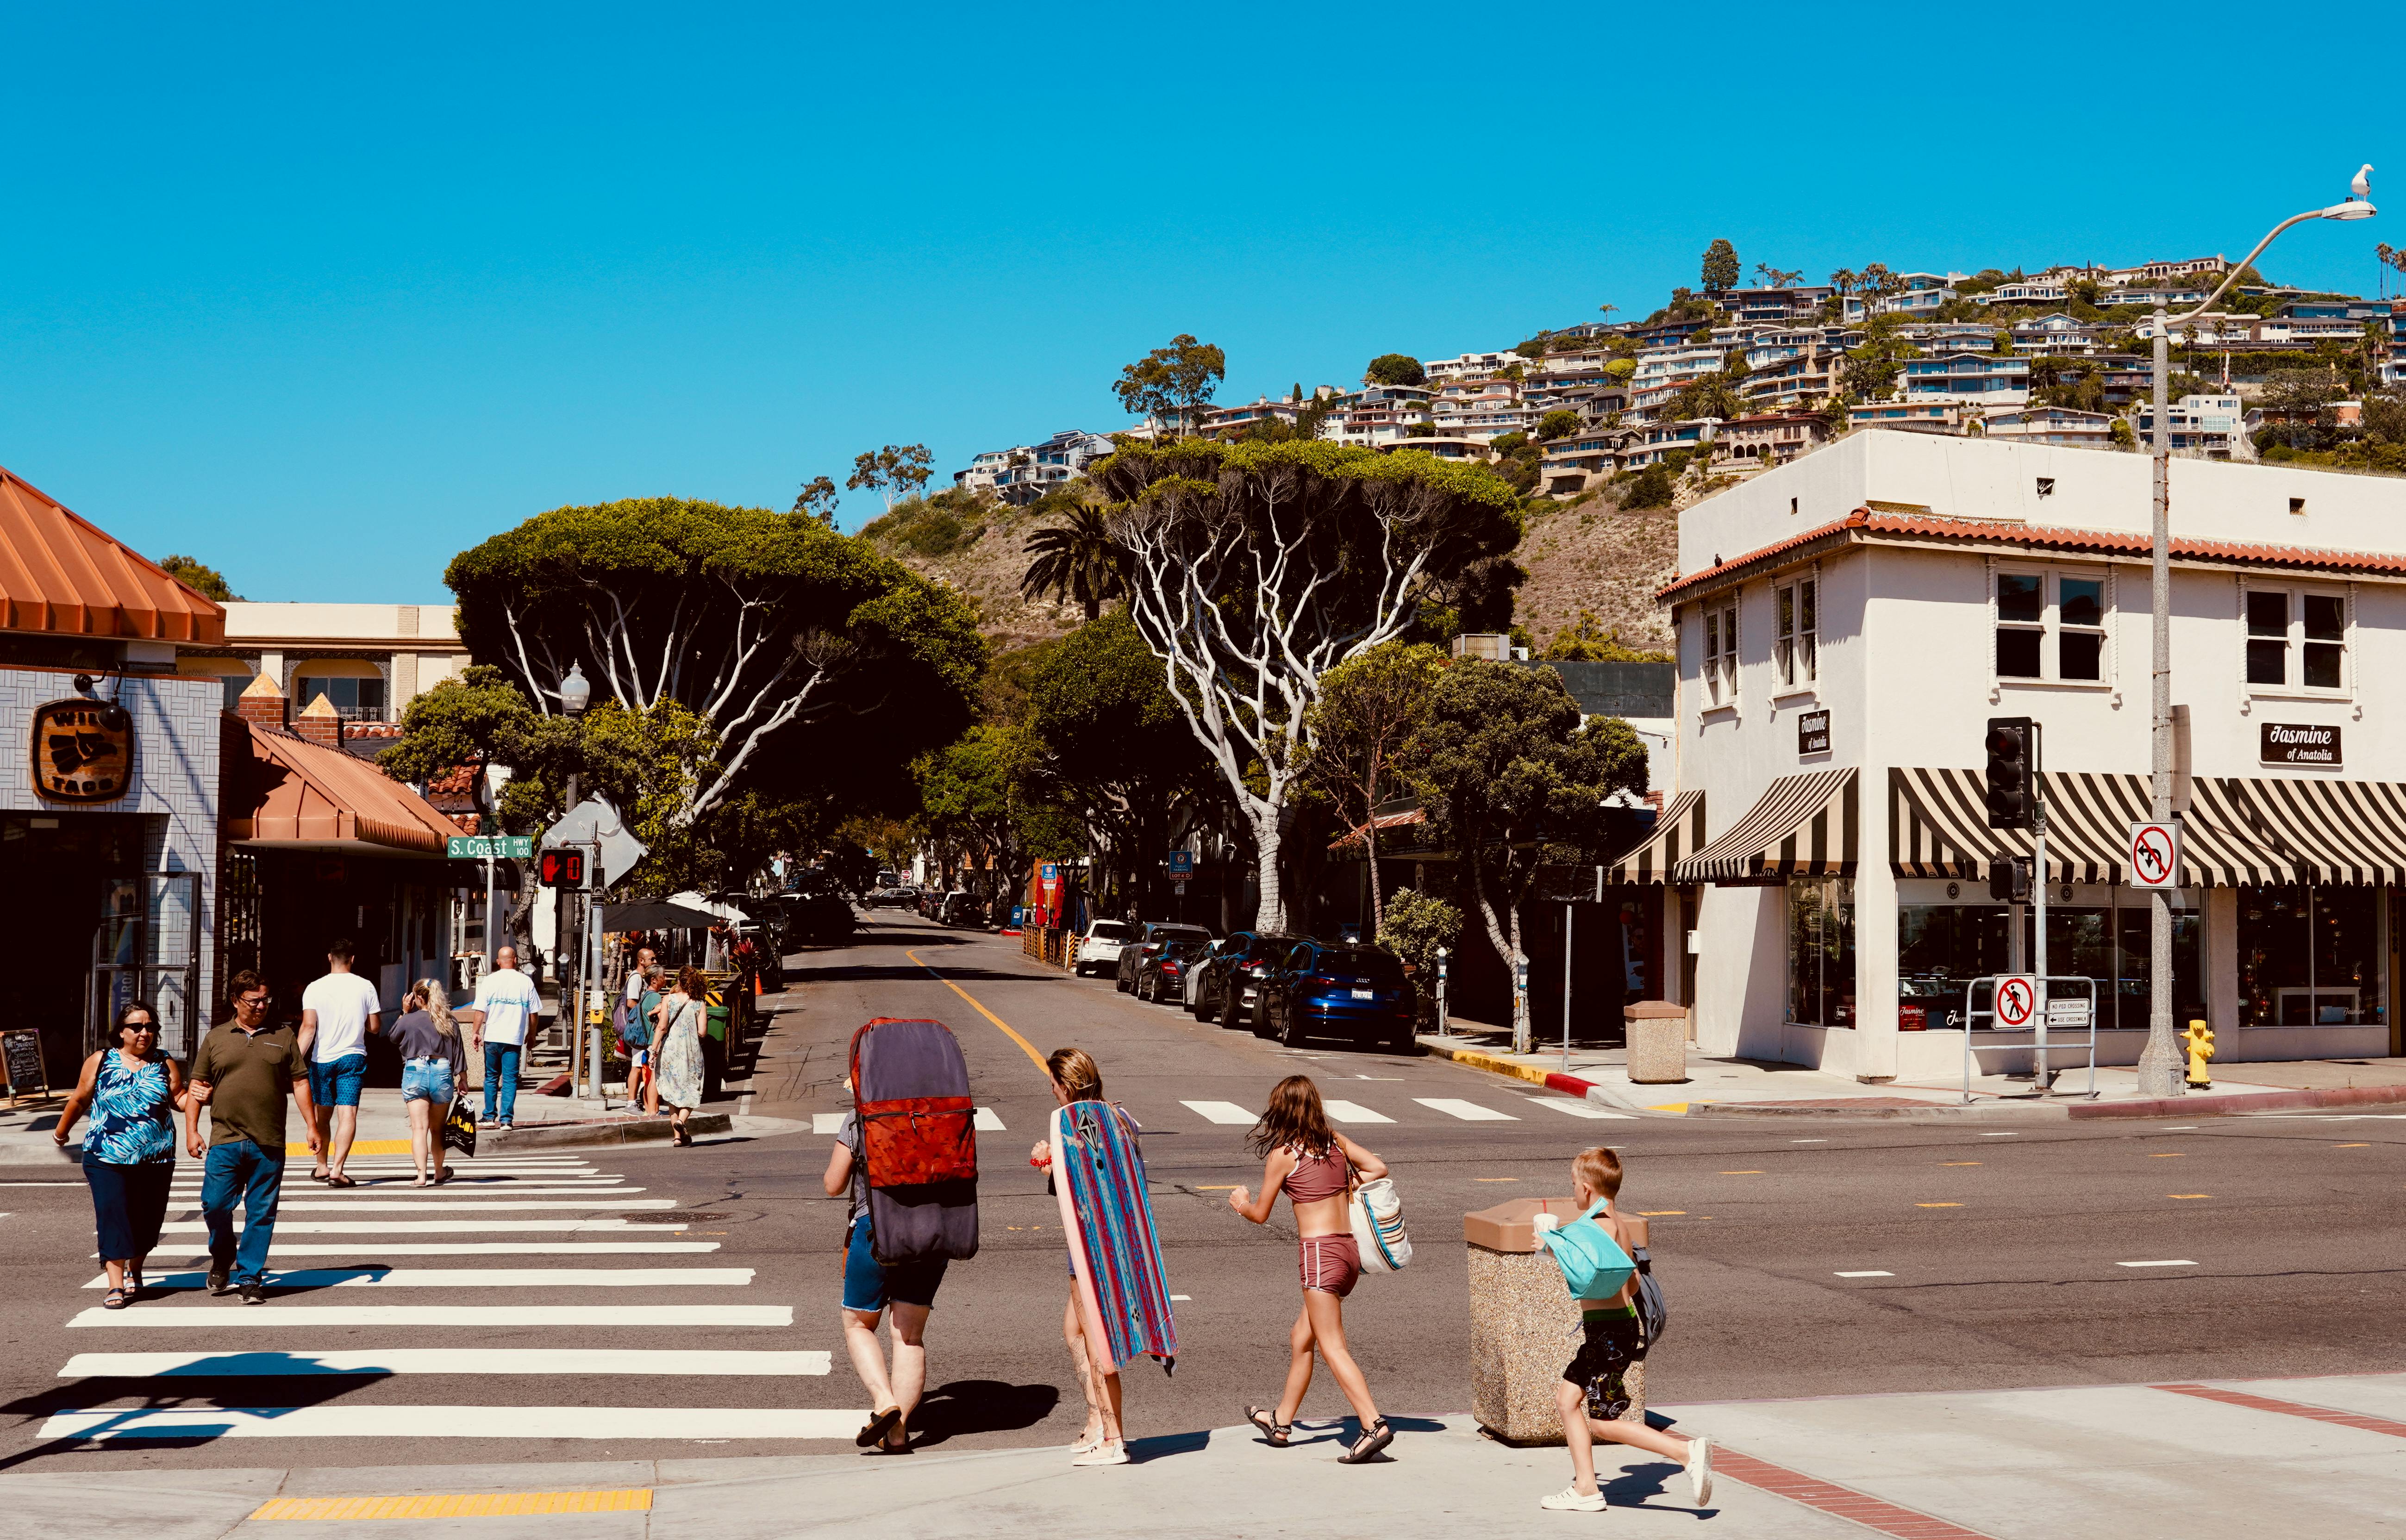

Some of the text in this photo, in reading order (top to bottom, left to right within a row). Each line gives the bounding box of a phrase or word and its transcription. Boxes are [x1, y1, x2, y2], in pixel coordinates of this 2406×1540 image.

[52, 711, 97, 727] WIL
[1801, 712, 1826, 734] Jasmine
[2270, 725, 2332, 744] Jasmine
[1808, 735, 1826, 751] of Anatolia
[2287, 748, 2332, 761] of Anatolia
[52, 776, 113, 794] TACO
[451, 839, 507, 855] S. Coast
[513, 838, 529, 847] HWY
[567, 857, 580, 879] 10
[1899, 1006, 1925, 1016] Jasmine
[2343, 1007, 2366, 1016] Jasmine
